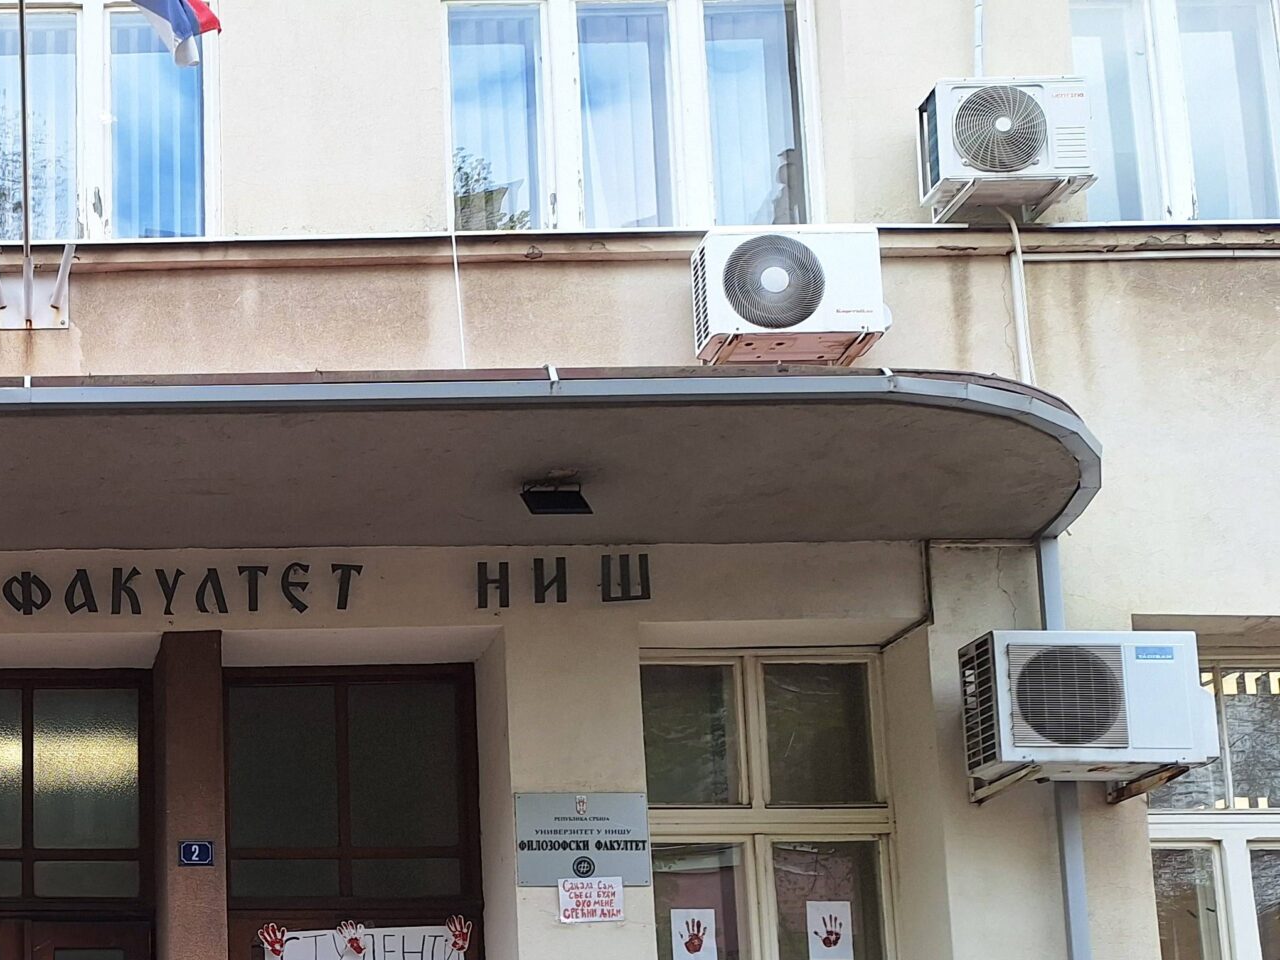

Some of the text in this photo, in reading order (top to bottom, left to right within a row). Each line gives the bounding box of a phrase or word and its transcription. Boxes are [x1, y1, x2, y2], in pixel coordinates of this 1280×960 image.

[2, 561, 364, 617] ФАКУЛТЕТ
[477, 553, 652, 610] НИШ
[191, 844, 200, 861] 2
[519, 840, 647, 851] ФИЛОЗОФСКИ ФАКУЛТЕТ
